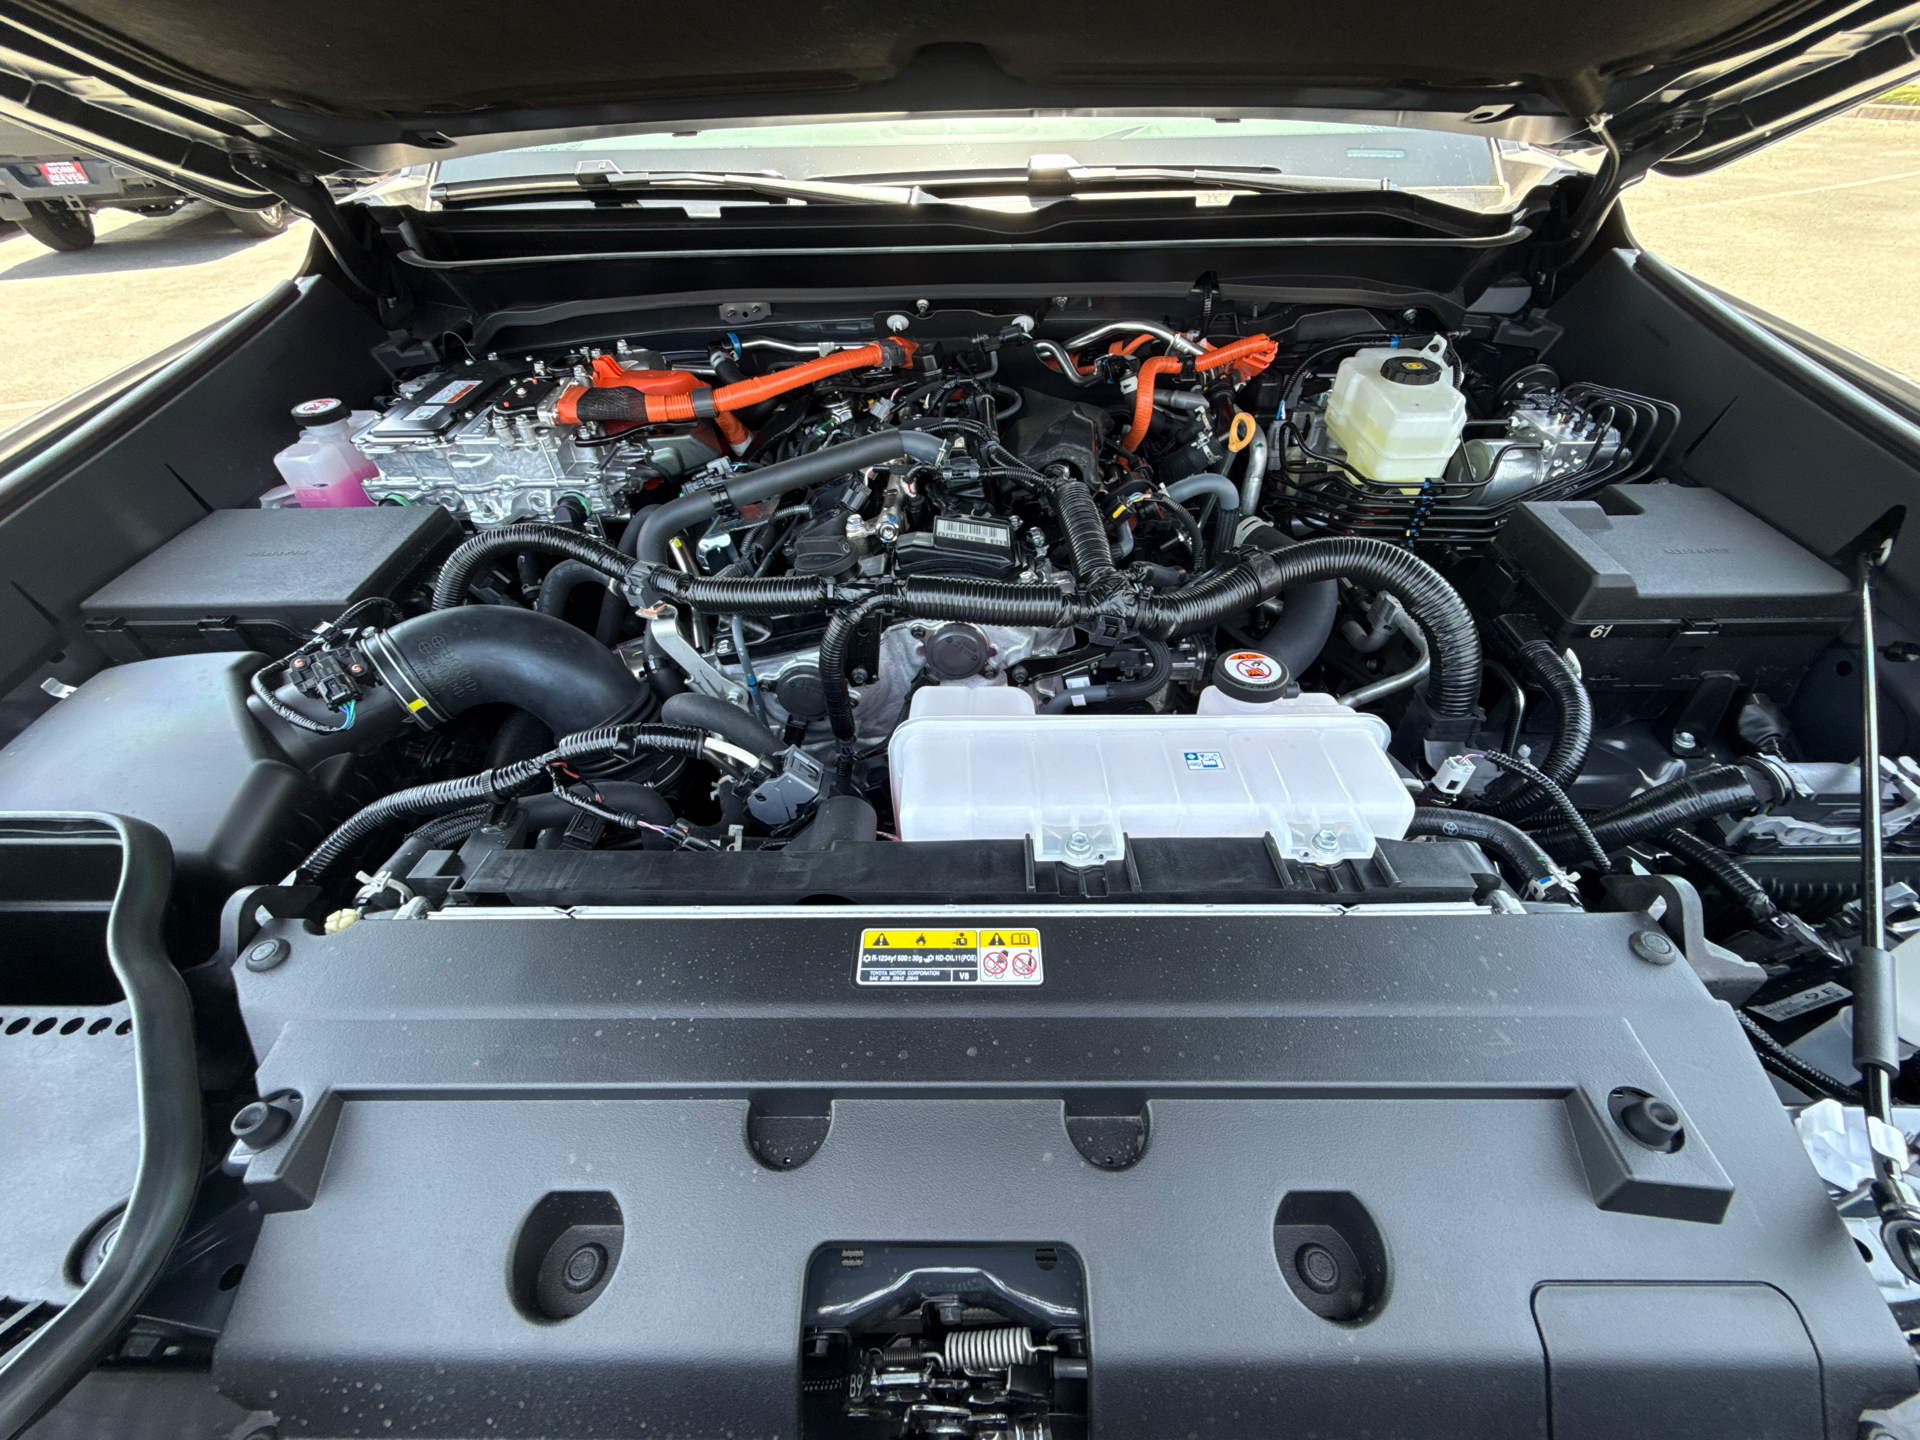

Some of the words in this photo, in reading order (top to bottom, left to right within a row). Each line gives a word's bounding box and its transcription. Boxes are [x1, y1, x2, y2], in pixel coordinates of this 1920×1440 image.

[47, 165, 77, 174] NORM
[48, 173, 85, 181] REEVES
[1590, 624, 1613, 638] 61
[871, 954, 896, 963] R-1234yf
